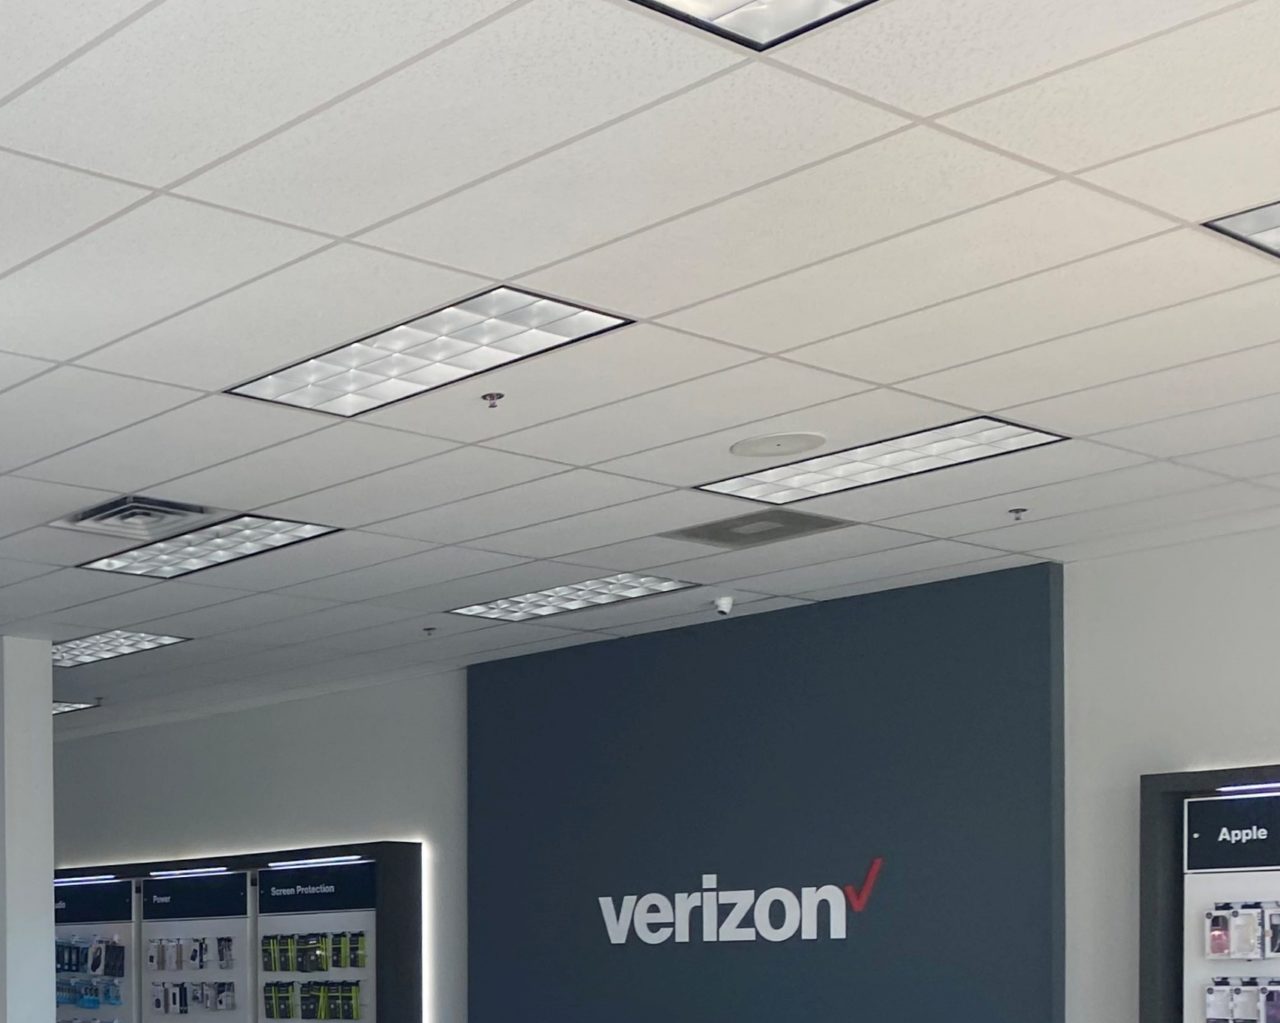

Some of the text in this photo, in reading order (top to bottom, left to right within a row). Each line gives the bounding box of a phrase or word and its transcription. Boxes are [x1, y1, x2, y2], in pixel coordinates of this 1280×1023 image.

[1218, 825, 1268, 844] Apple
[270, 884, 335, 896] Screen Protection
[598, 874, 847, 945] verizon
